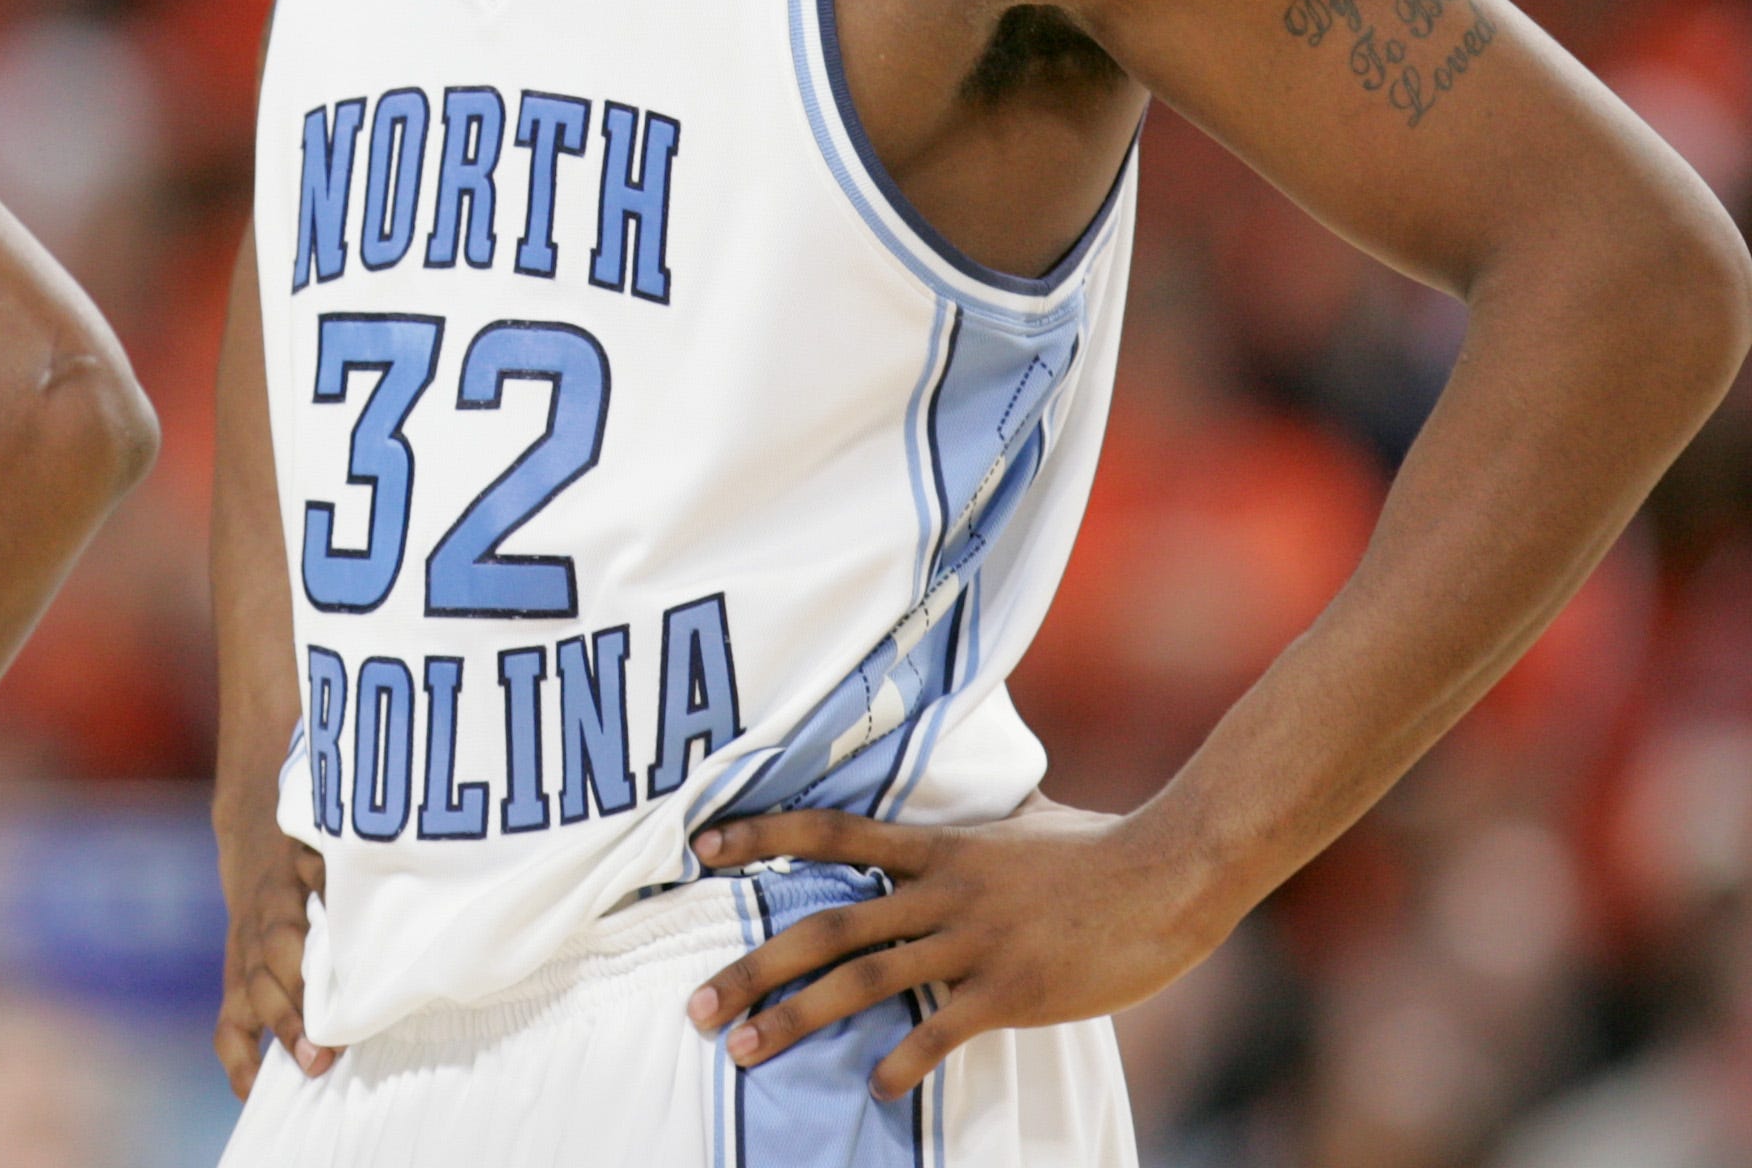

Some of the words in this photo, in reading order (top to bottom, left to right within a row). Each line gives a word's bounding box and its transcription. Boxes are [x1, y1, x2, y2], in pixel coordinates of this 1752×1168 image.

[1350, 25, 1406, 91] To
[1389, 0, 1498, 128] Loved
[291, 84, 681, 306] NORTH
[301, 312, 612, 620] 32
